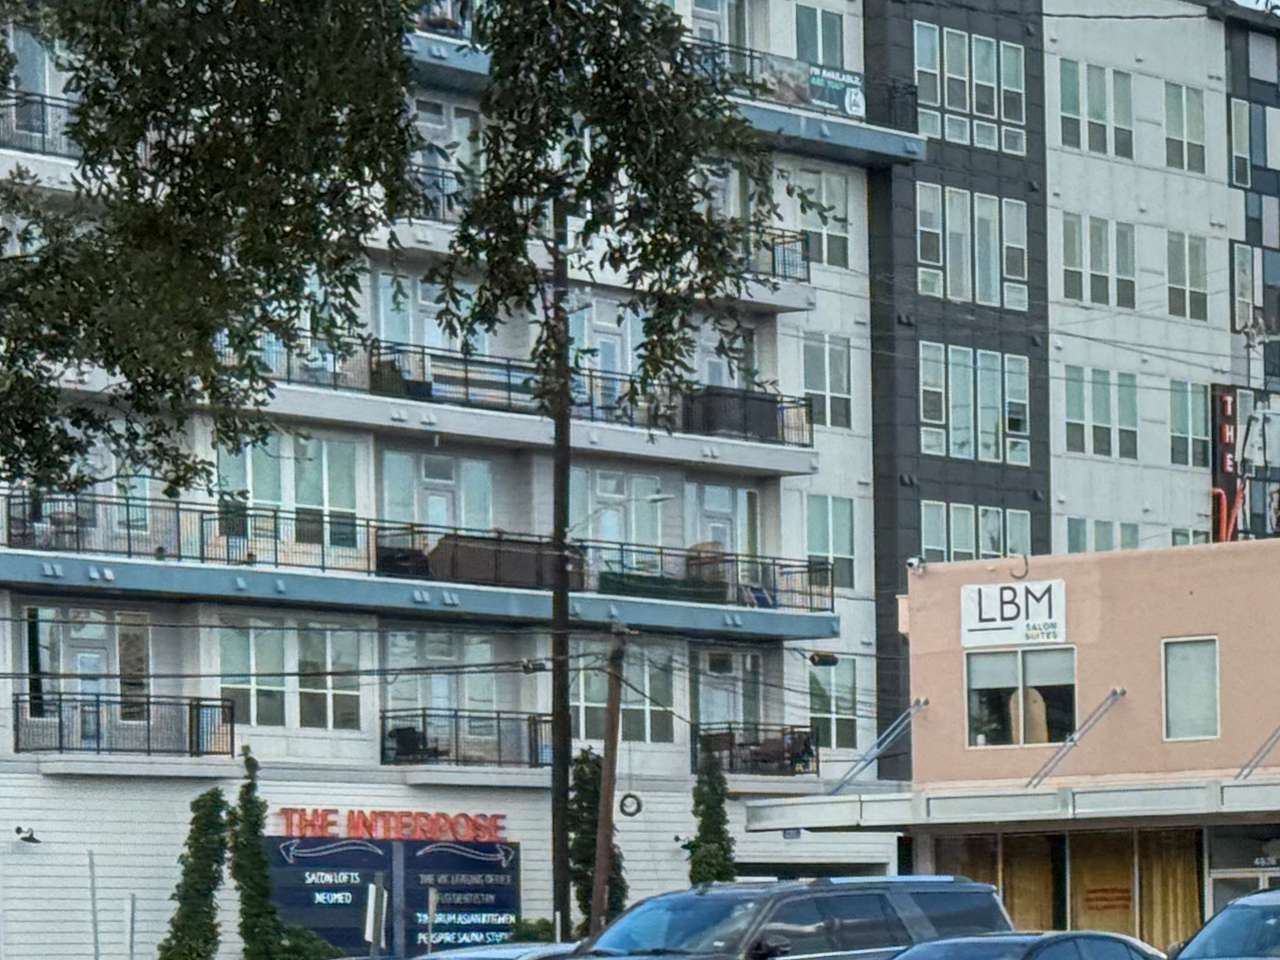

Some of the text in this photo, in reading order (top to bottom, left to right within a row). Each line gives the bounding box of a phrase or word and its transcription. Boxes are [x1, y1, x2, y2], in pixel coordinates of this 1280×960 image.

[1221, 394, 1235, 473] THE
[978, 583, 1052, 623] LBM
[1025, 621, 1058, 631] SALON
[1025, 631, 1058, 641] SUITES
[278, 807, 507, 842] THE INTERPOSE
